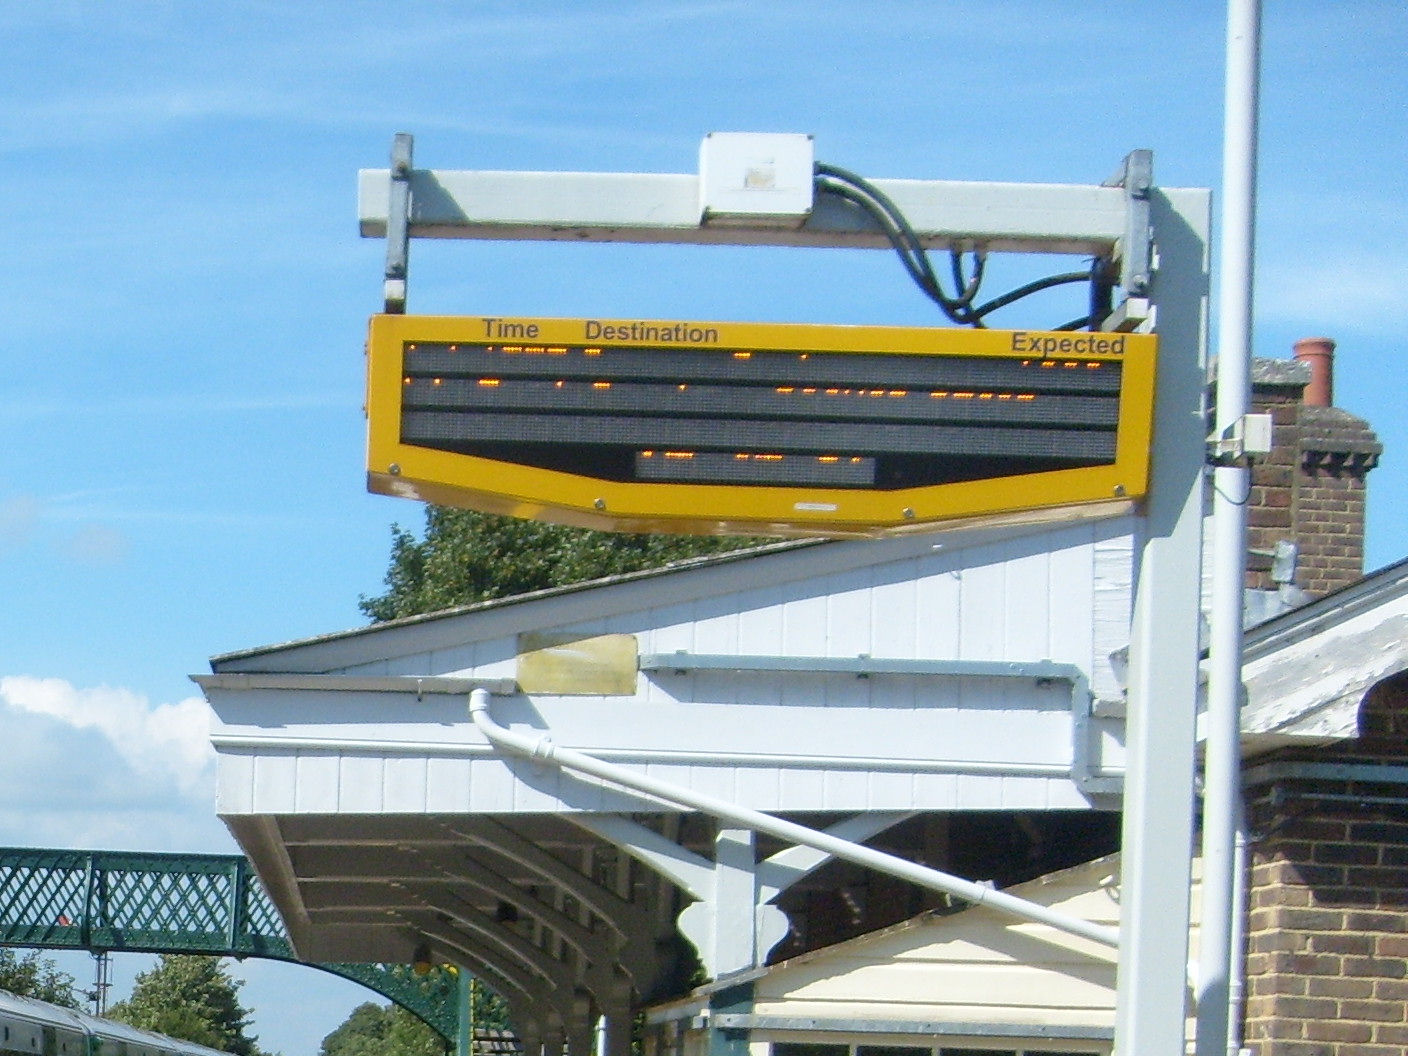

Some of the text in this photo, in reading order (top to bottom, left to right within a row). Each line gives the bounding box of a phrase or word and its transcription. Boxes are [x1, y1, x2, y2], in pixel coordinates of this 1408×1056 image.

[482, 318, 539, 338] Time
[584, 320, 719, 343] Destination
[1012, 332, 1125, 358] Expected
